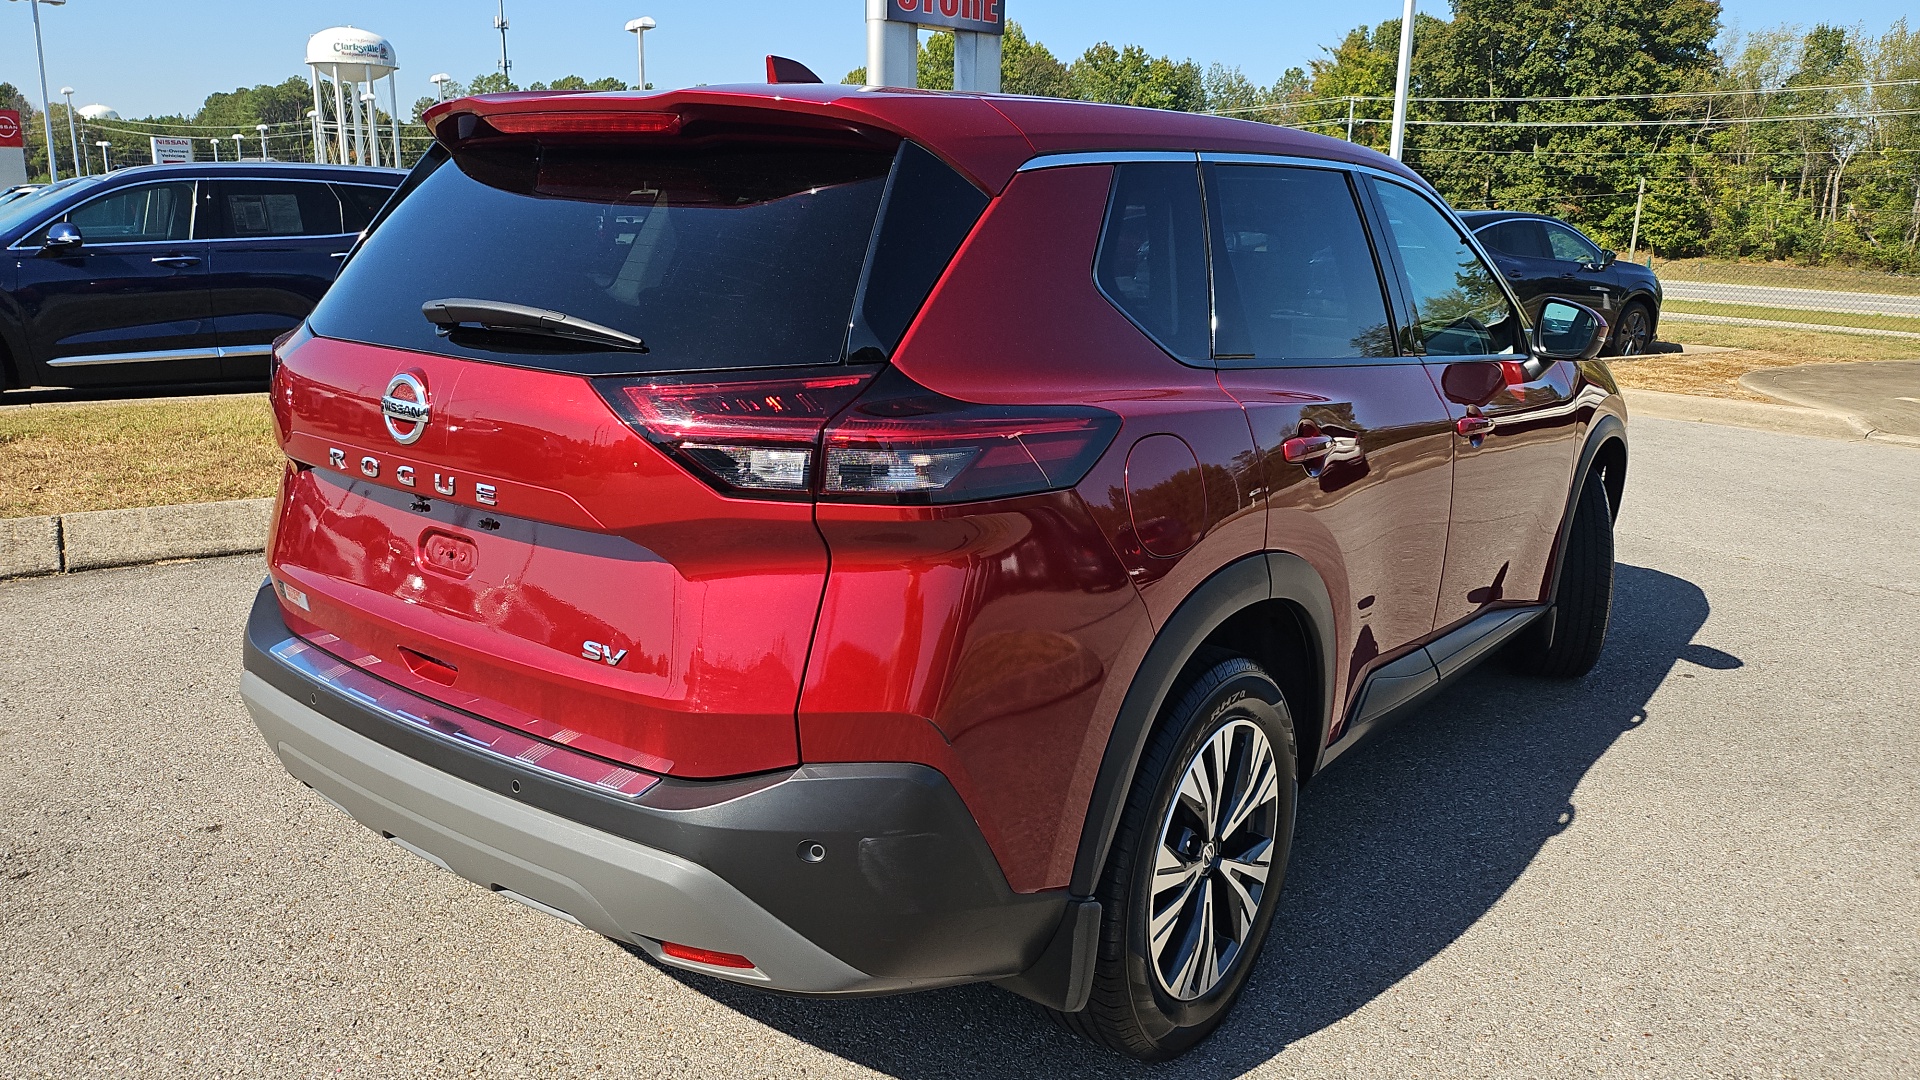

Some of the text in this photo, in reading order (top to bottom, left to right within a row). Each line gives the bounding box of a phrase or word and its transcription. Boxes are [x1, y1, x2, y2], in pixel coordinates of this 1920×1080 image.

[333, 42, 379, 53] Clarksville
[384, 399, 421, 418] NISSAN
[329, 447, 499, 506] ROGUE
[581, 639, 629, 666] SV
